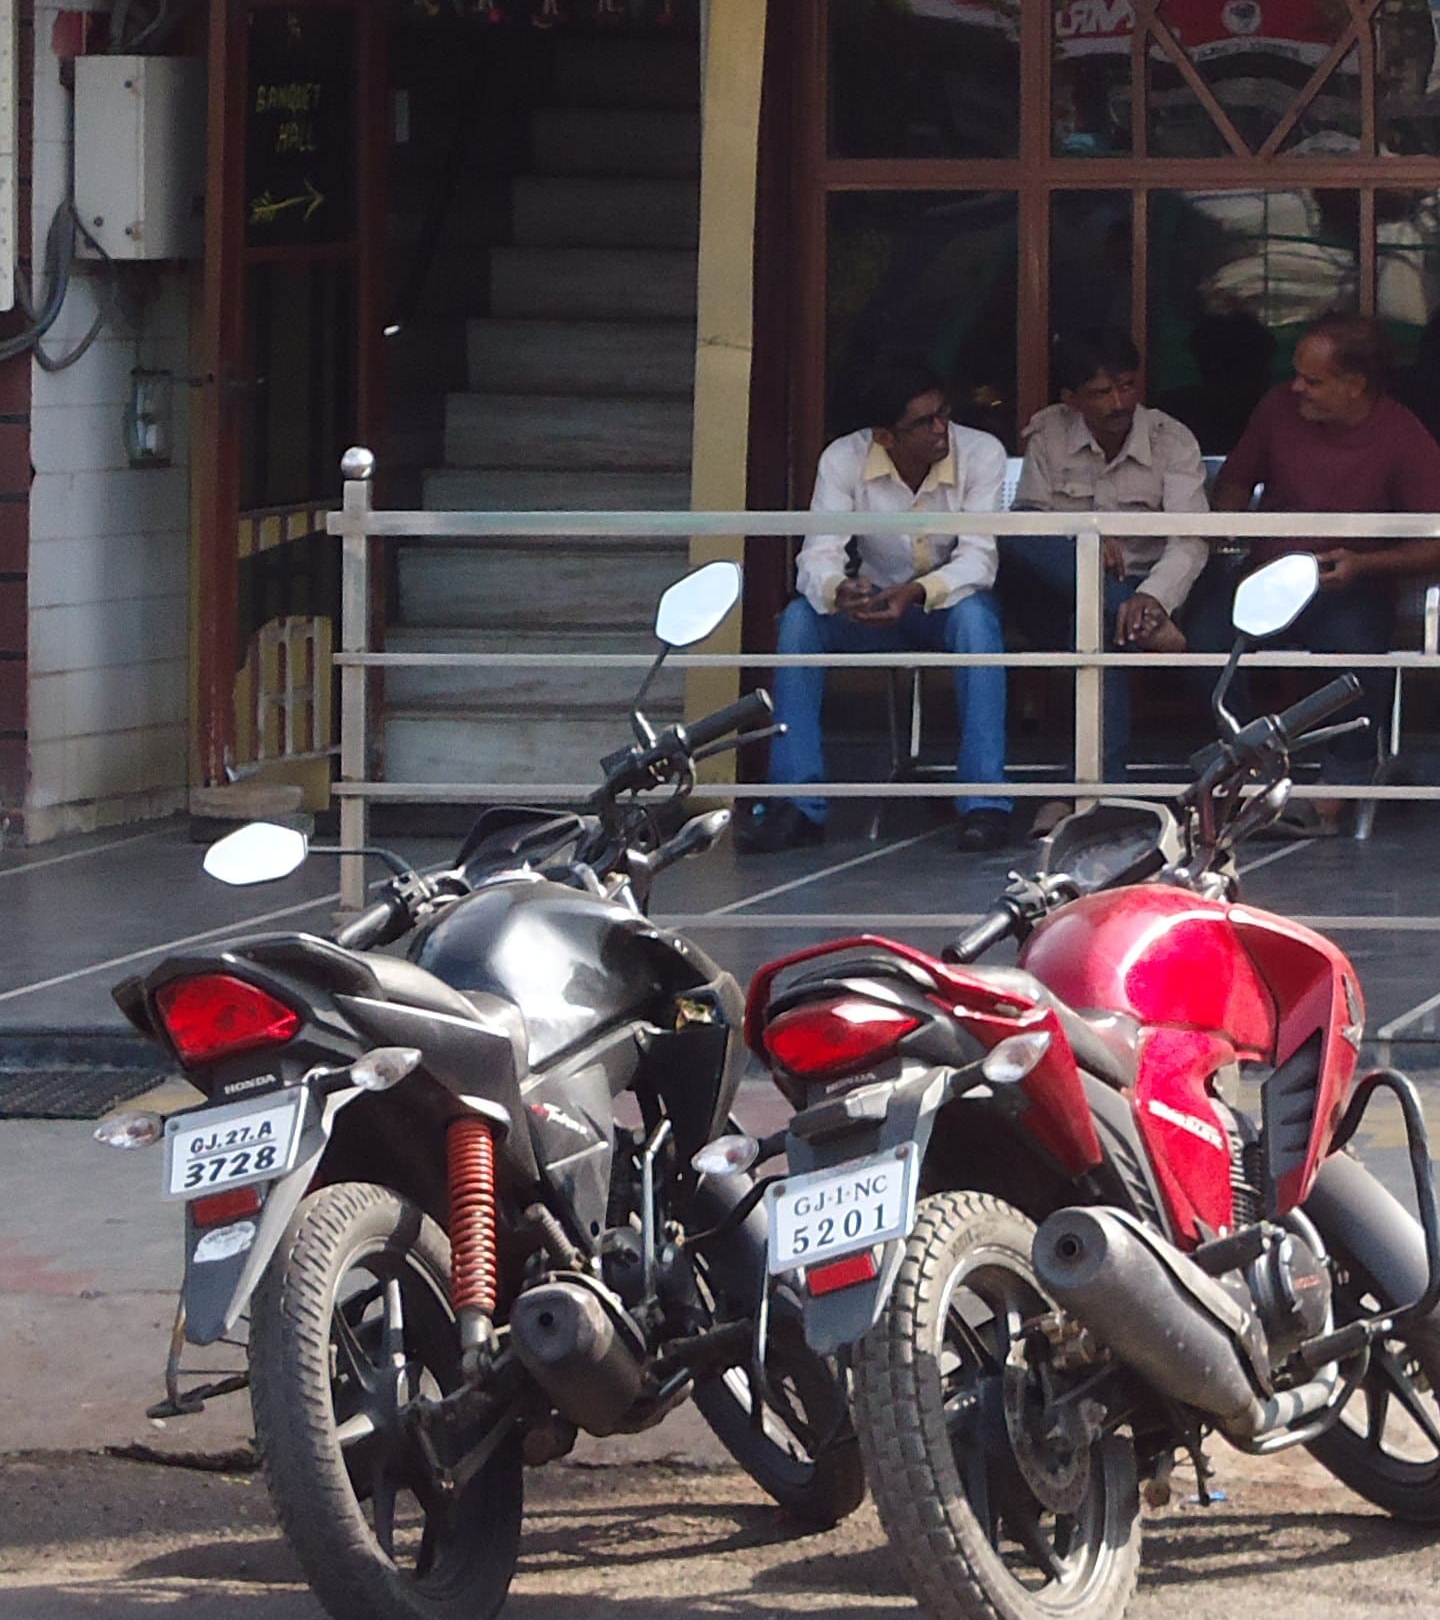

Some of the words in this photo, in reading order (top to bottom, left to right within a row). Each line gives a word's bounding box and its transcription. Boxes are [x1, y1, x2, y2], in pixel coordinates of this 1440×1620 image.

[275, 122, 318, 155] HALL
[223, 1073, 277, 1095] HONDA
[183, 1145, 277, 1189] 3728
[791, 1203, 887, 1255] 5201
